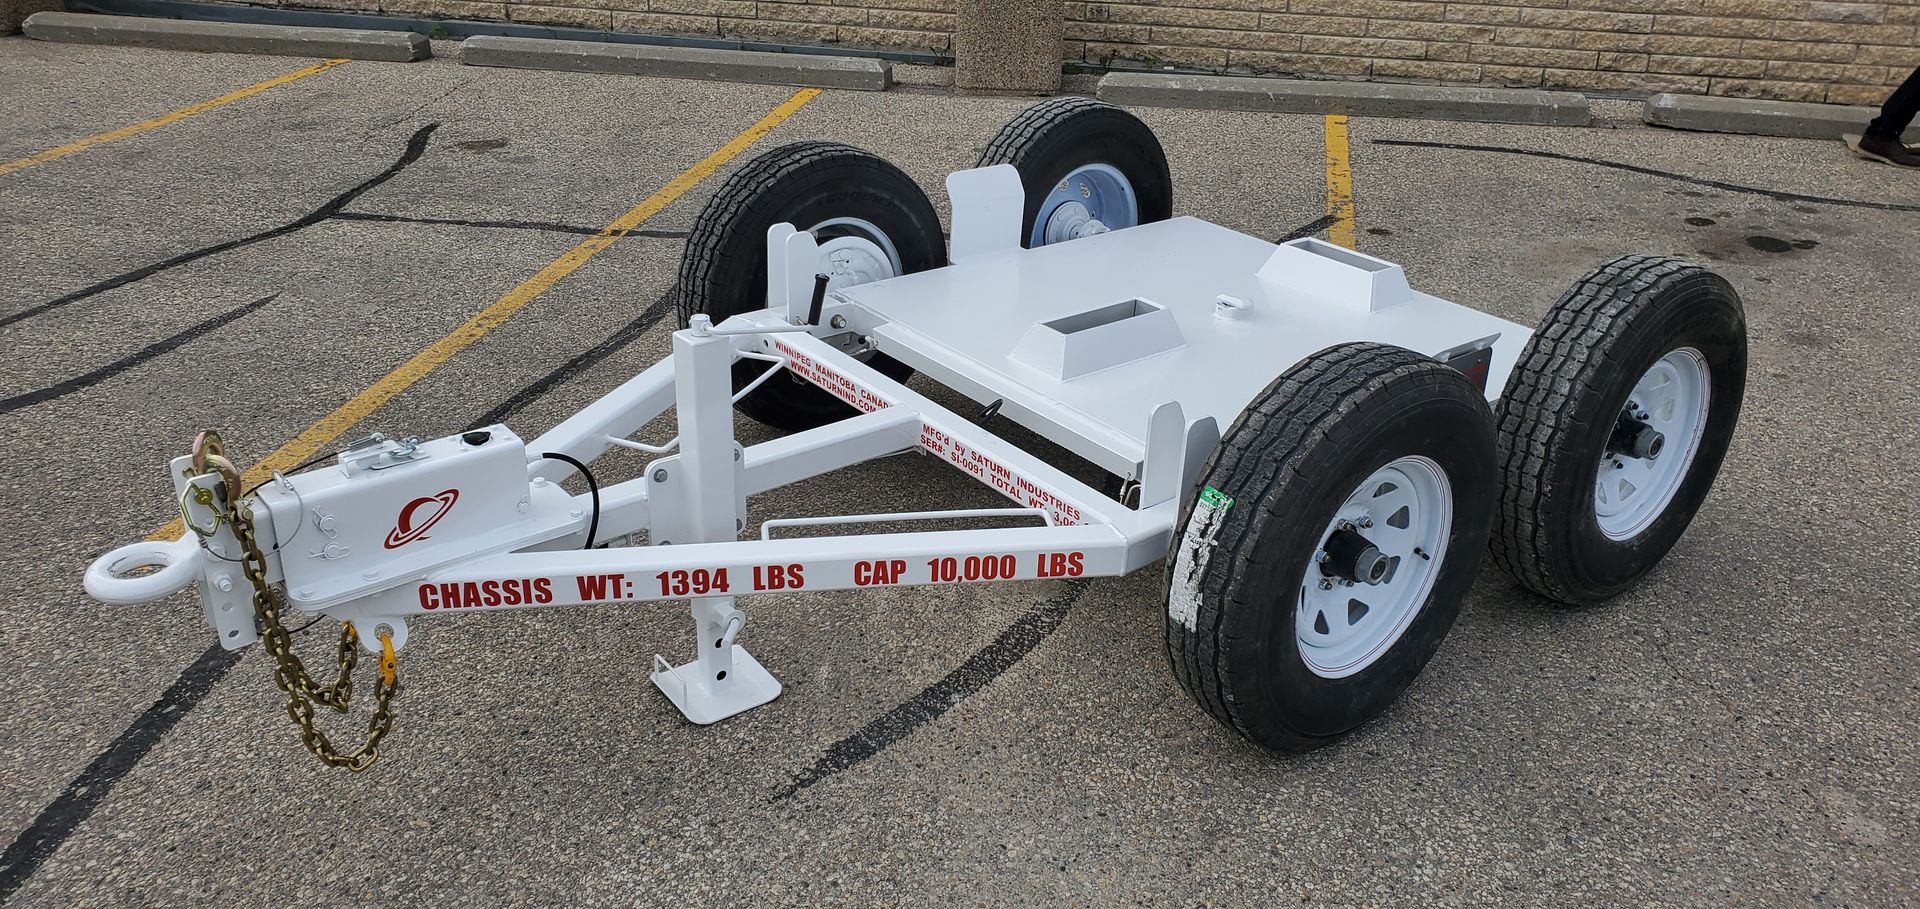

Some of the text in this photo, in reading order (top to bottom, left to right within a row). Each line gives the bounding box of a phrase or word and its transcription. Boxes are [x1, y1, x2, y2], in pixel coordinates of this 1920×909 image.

[775, 340, 893, 409] WINNIPEG MANITOBA CANAD
[790, 359, 876, 413] WWW.SATURNIND.COM
[920, 434, 946, 456] SER#:
[950, 452, 984, 478] SI-0091
[990, 473, 1023, 500] TOTAL
[954, 441, 966, 456] by
[970, 450, 1011, 480] SATURN
[1017, 476, 1080, 520] INDUSTRIES
[418, 551, 1085, 610] CHASSIS WT: 1394 LBS CAP 10,000 LBS
